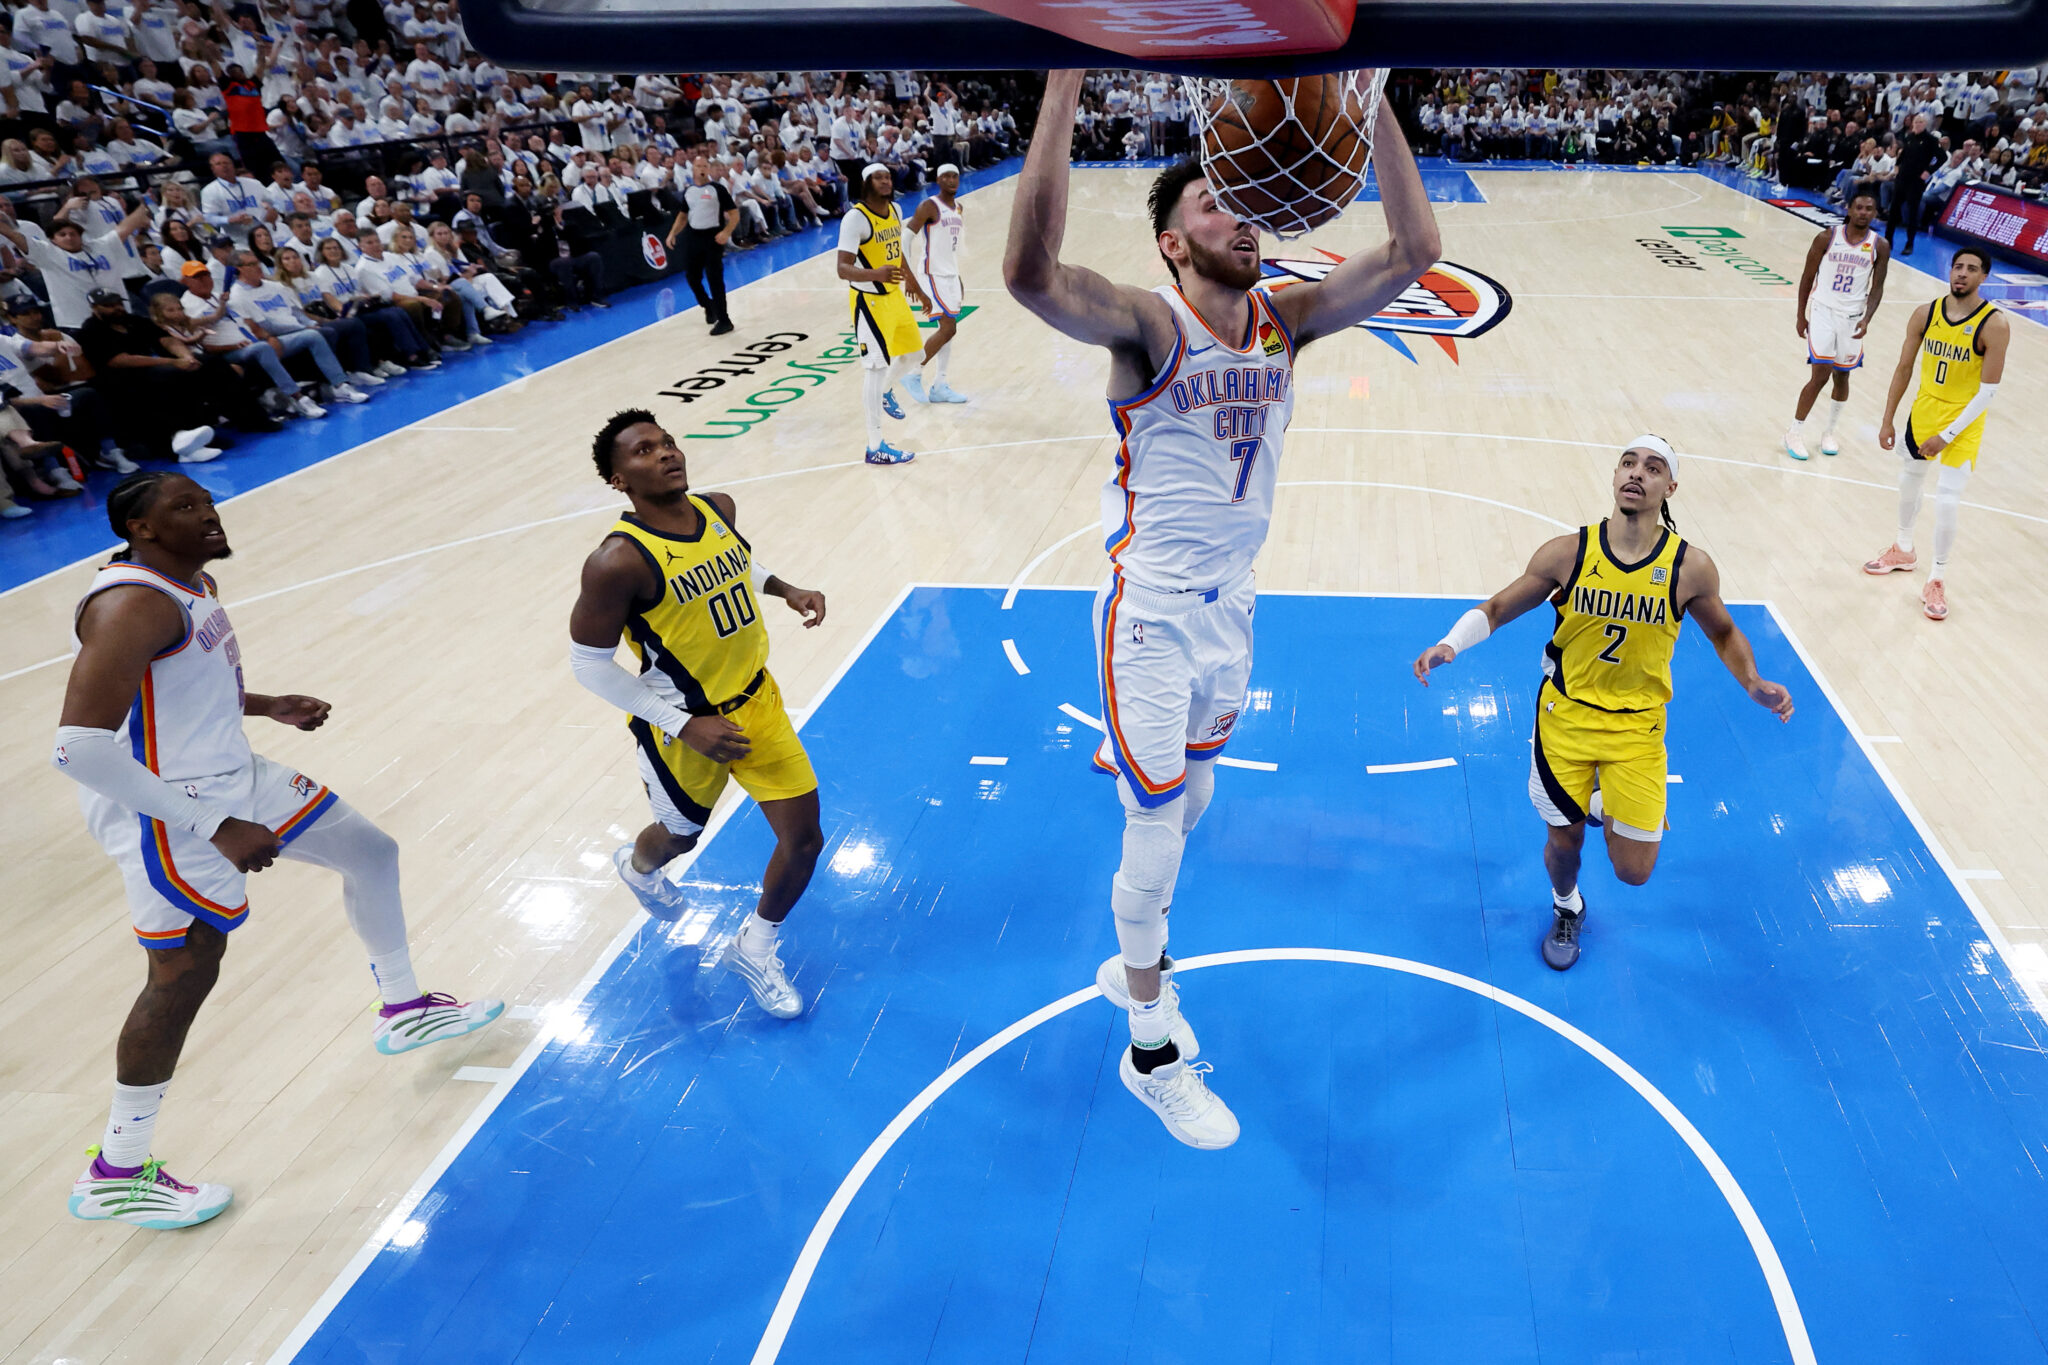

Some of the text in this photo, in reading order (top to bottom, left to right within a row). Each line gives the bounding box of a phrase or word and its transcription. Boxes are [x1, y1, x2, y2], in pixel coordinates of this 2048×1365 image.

[874, 225, 901, 244] INDIAN
[885, 240, 900, 261] 33
[1635, 238, 1706, 272] center
[1681, 238, 1794, 286] paycom
[1828, 252, 1871, 268] OKLAHOMA
[1837, 263, 1856, 274] CITY
[1832, 274, 1854, 293] 22
[658, 332, 809, 403] center
[1924, 337, 1970, 362] INDIANA
[1170, 367, 1292, 414] OKLAHMA
[1935, 360, 1948, 384] 0
[1214, 403, 1270, 440] CITY
[1230, 437, 1263, 503] 7
[669, 544, 749, 605] INDIANA
[708, 581, 756, 639] 00
[1574, 586, 1667, 625] INDIANA
[1598, 623, 1628, 665] 2
